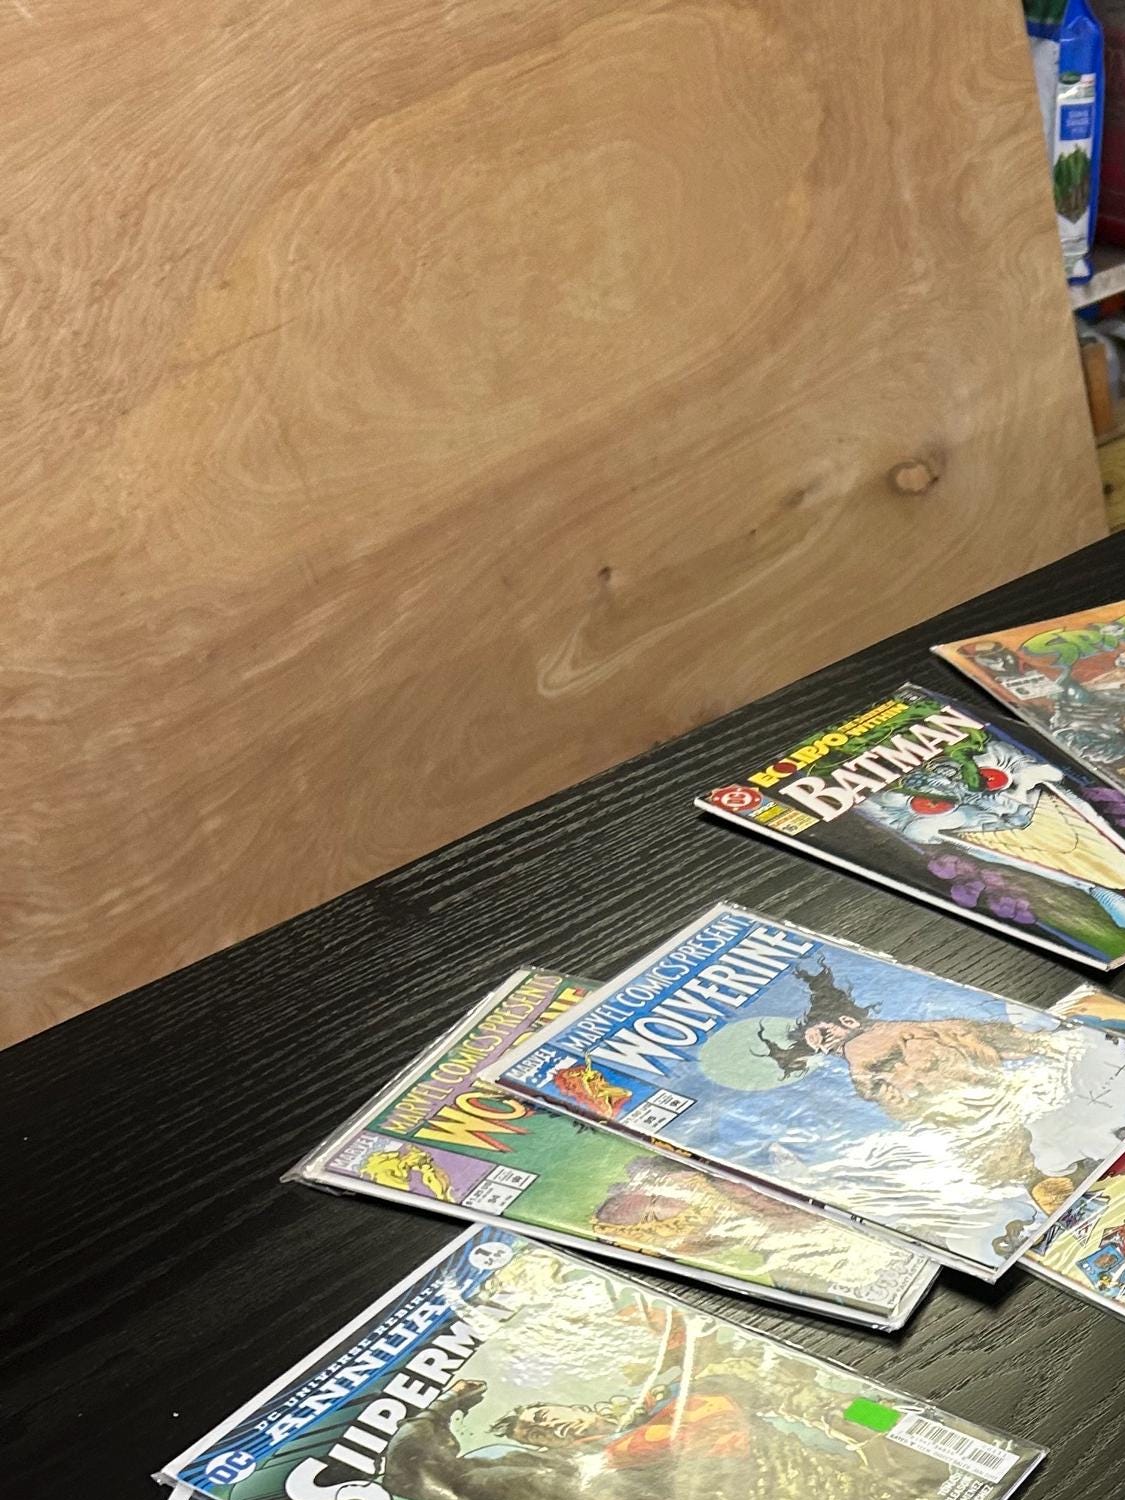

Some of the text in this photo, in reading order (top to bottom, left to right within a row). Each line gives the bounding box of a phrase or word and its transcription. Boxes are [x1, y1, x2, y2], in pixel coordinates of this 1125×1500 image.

[747, 732, 849, 789] ECLIPSO
[779, 705, 985, 822] BATMAN
[561, 1002, 627, 1052] MARVEL
[617, 960, 690, 1014] COMICS
[591, 926, 814, 1077] WOLVERINE
[380, 974, 563, 1135] MARVEL COMICS PRESENTS
[505, 1047, 556, 1080] MARVEL
[255, 1408, 284, 1431] DC
[284, 1338, 372, 1405] UNIVERSE
[209, 1449, 256, 1484] DC
